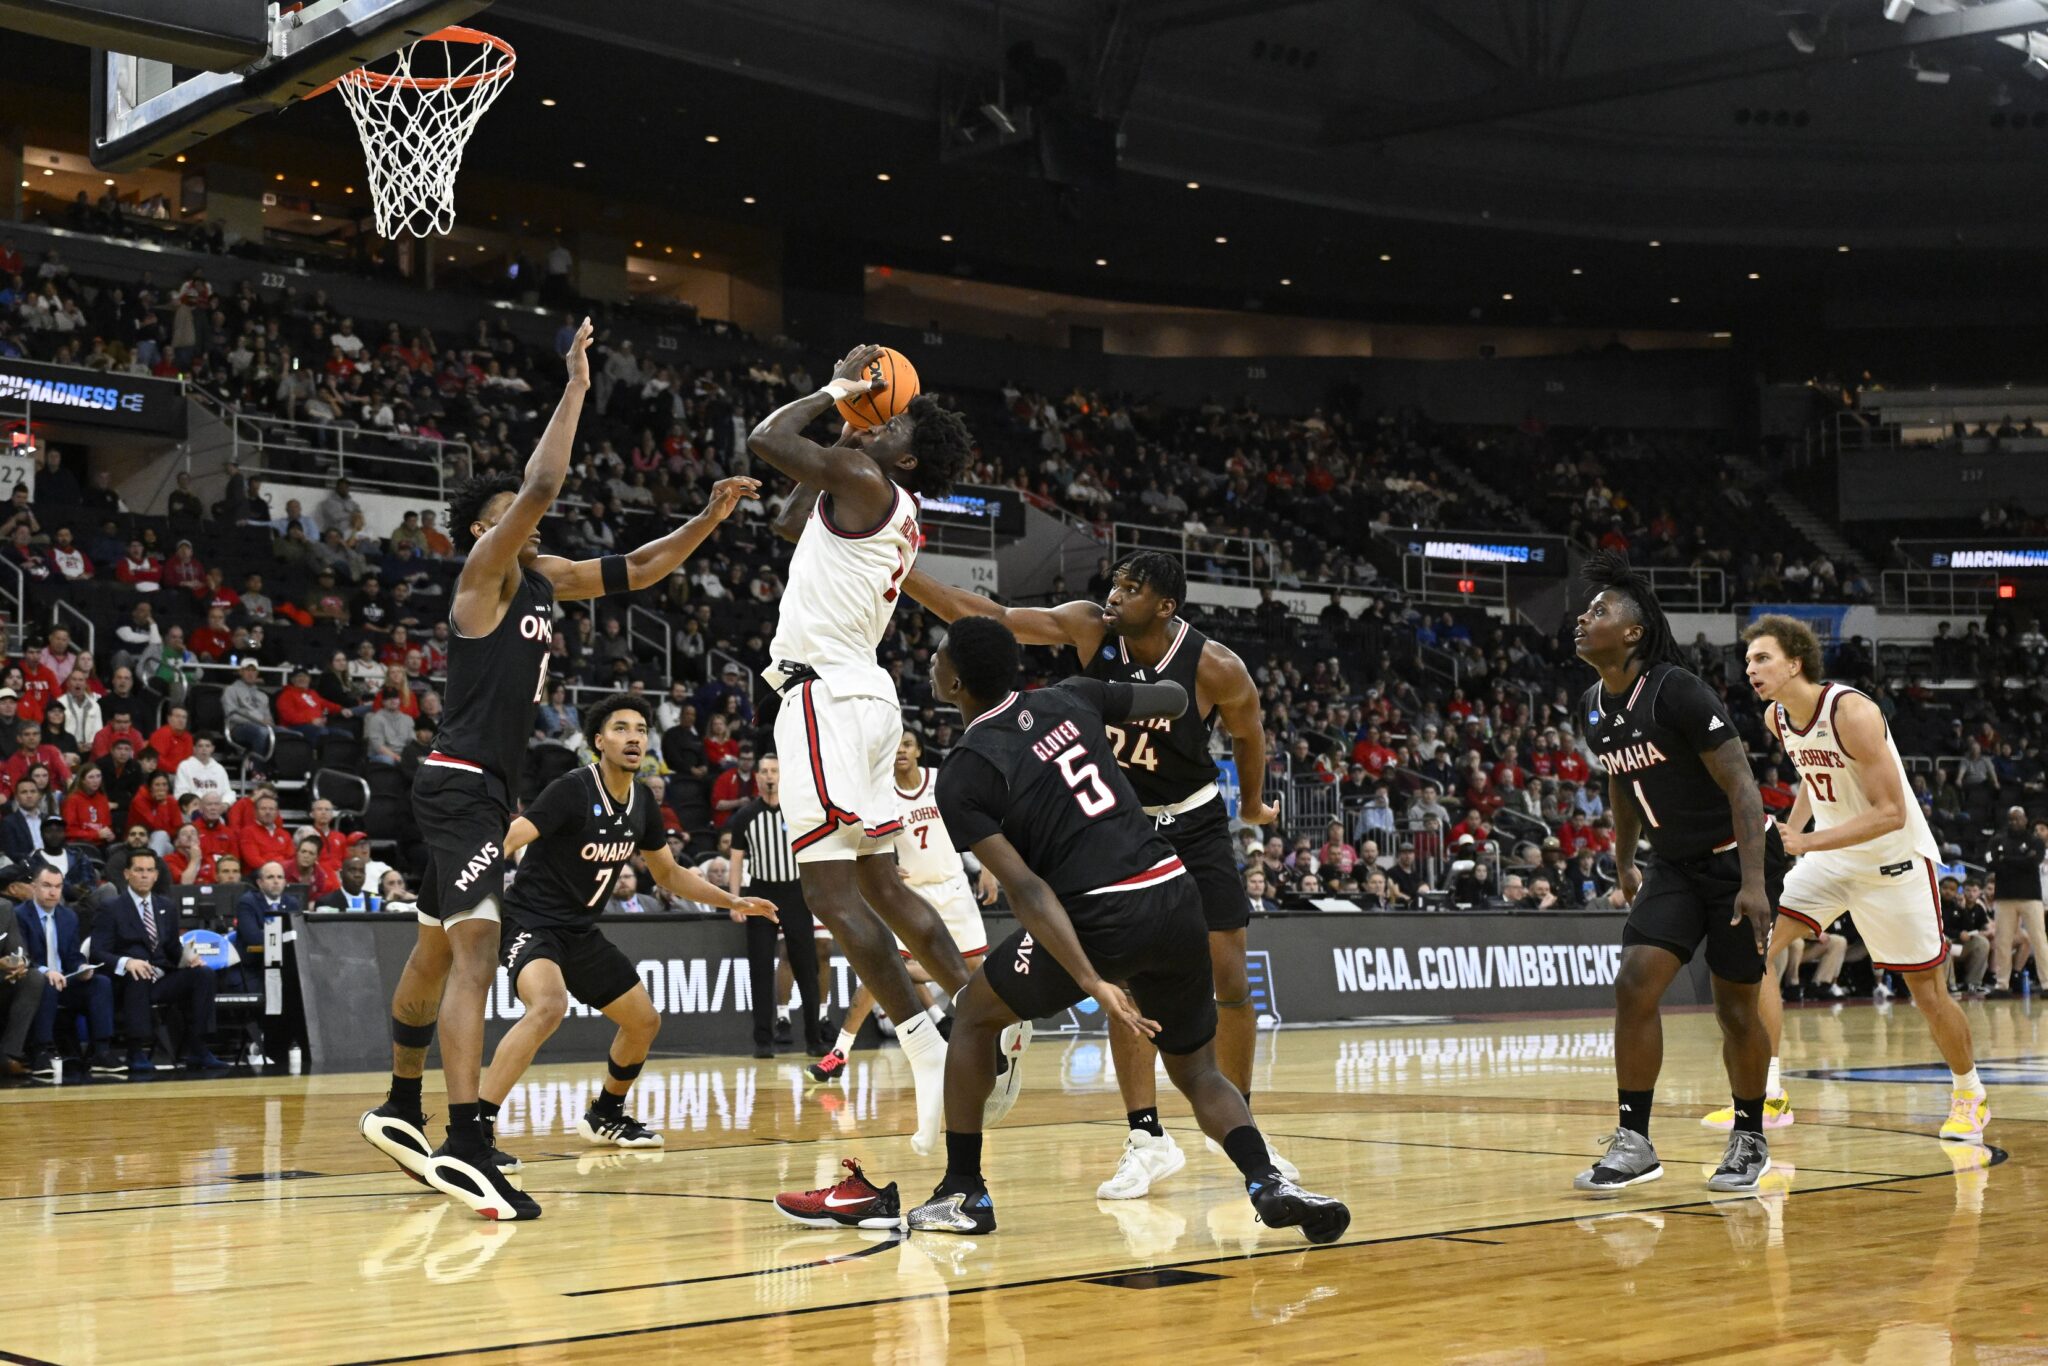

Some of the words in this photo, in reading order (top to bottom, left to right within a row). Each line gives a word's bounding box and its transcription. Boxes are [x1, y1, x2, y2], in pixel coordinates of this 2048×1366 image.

[261, 271, 286, 289] 232
[971, 567, 993, 581] 124
[1031, 719, 1082, 762] GLOVER
[1105, 724, 1158, 772] 24
[1598, 741, 1667, 775] OMAHA
[1798, 749, 1845, 768] JOHN'S
[1053, 743, 1117, 818] 5
[1804, 772, 1837, 803] 17
[1632, 780, 1661, 828] 1
[580, 841, 636, 862] OMAHA
[913, 825, 929, 850] 7
[454, 841, 500, 892] MAVS
[586, 867, 614, 907] 7
[507, 931, 533, 968] MAVS
[1013, 931, 1035, 975] AVS
